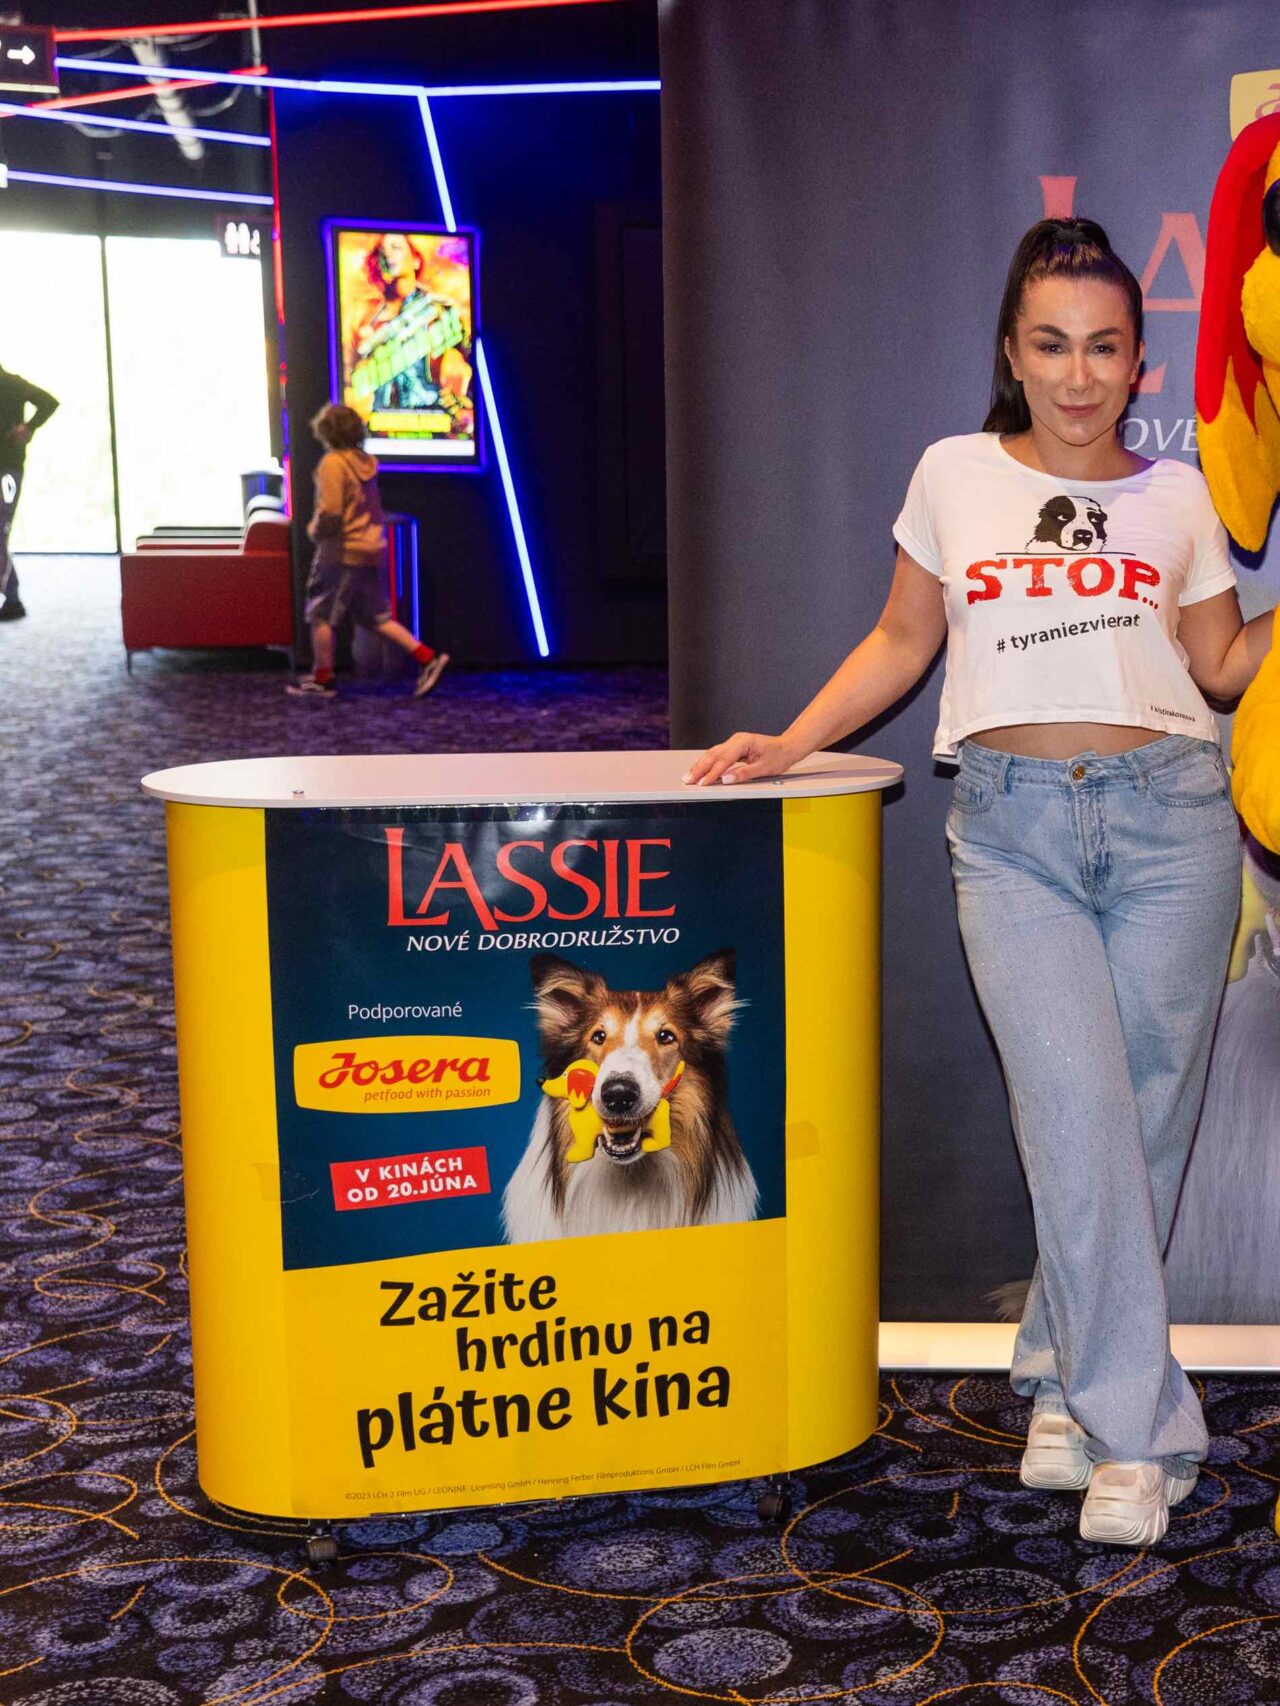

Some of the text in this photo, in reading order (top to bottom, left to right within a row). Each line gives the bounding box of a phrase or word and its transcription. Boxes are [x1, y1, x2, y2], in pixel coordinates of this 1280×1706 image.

[384, 827, 677, 931] LASSIE
[406, 925, 680, 951] NOVÉ DOBRODRUŽSTVO
[348, 1001, 463, 1023] Podporované
[318, 1052, 491, 1089] Josera
[364, 1085, 491, 1103] petfood with passion
[355, 1156, 463, 1183] V KINÁCH
[347, 1186, 379, 1203] OD
[379, 1268, 558, 1327] Zažite
[456, 1310, 711, 1372] hrdinu na
[356, 1361, 731, 1469] plátne kina
[397, 1489, 412, 1498] Film
[413, 1488, 426, 1496] UG
[470, 1482, 506, 1492] Licensing
[507, 1480, 532, 1489] GmbH
[538, 1475, 570, 1486] Henning
[570, 1473, 595, 1482] Ferber
[596, 1468, 655, 1480] Filmproduktions
[656, 1466, 680, 1475] GmbH
[685, 1463, 700, 1472] LCH
[701, 1461, 717, 1470] Film
[718, 1459, 741, 1469] GmbH
